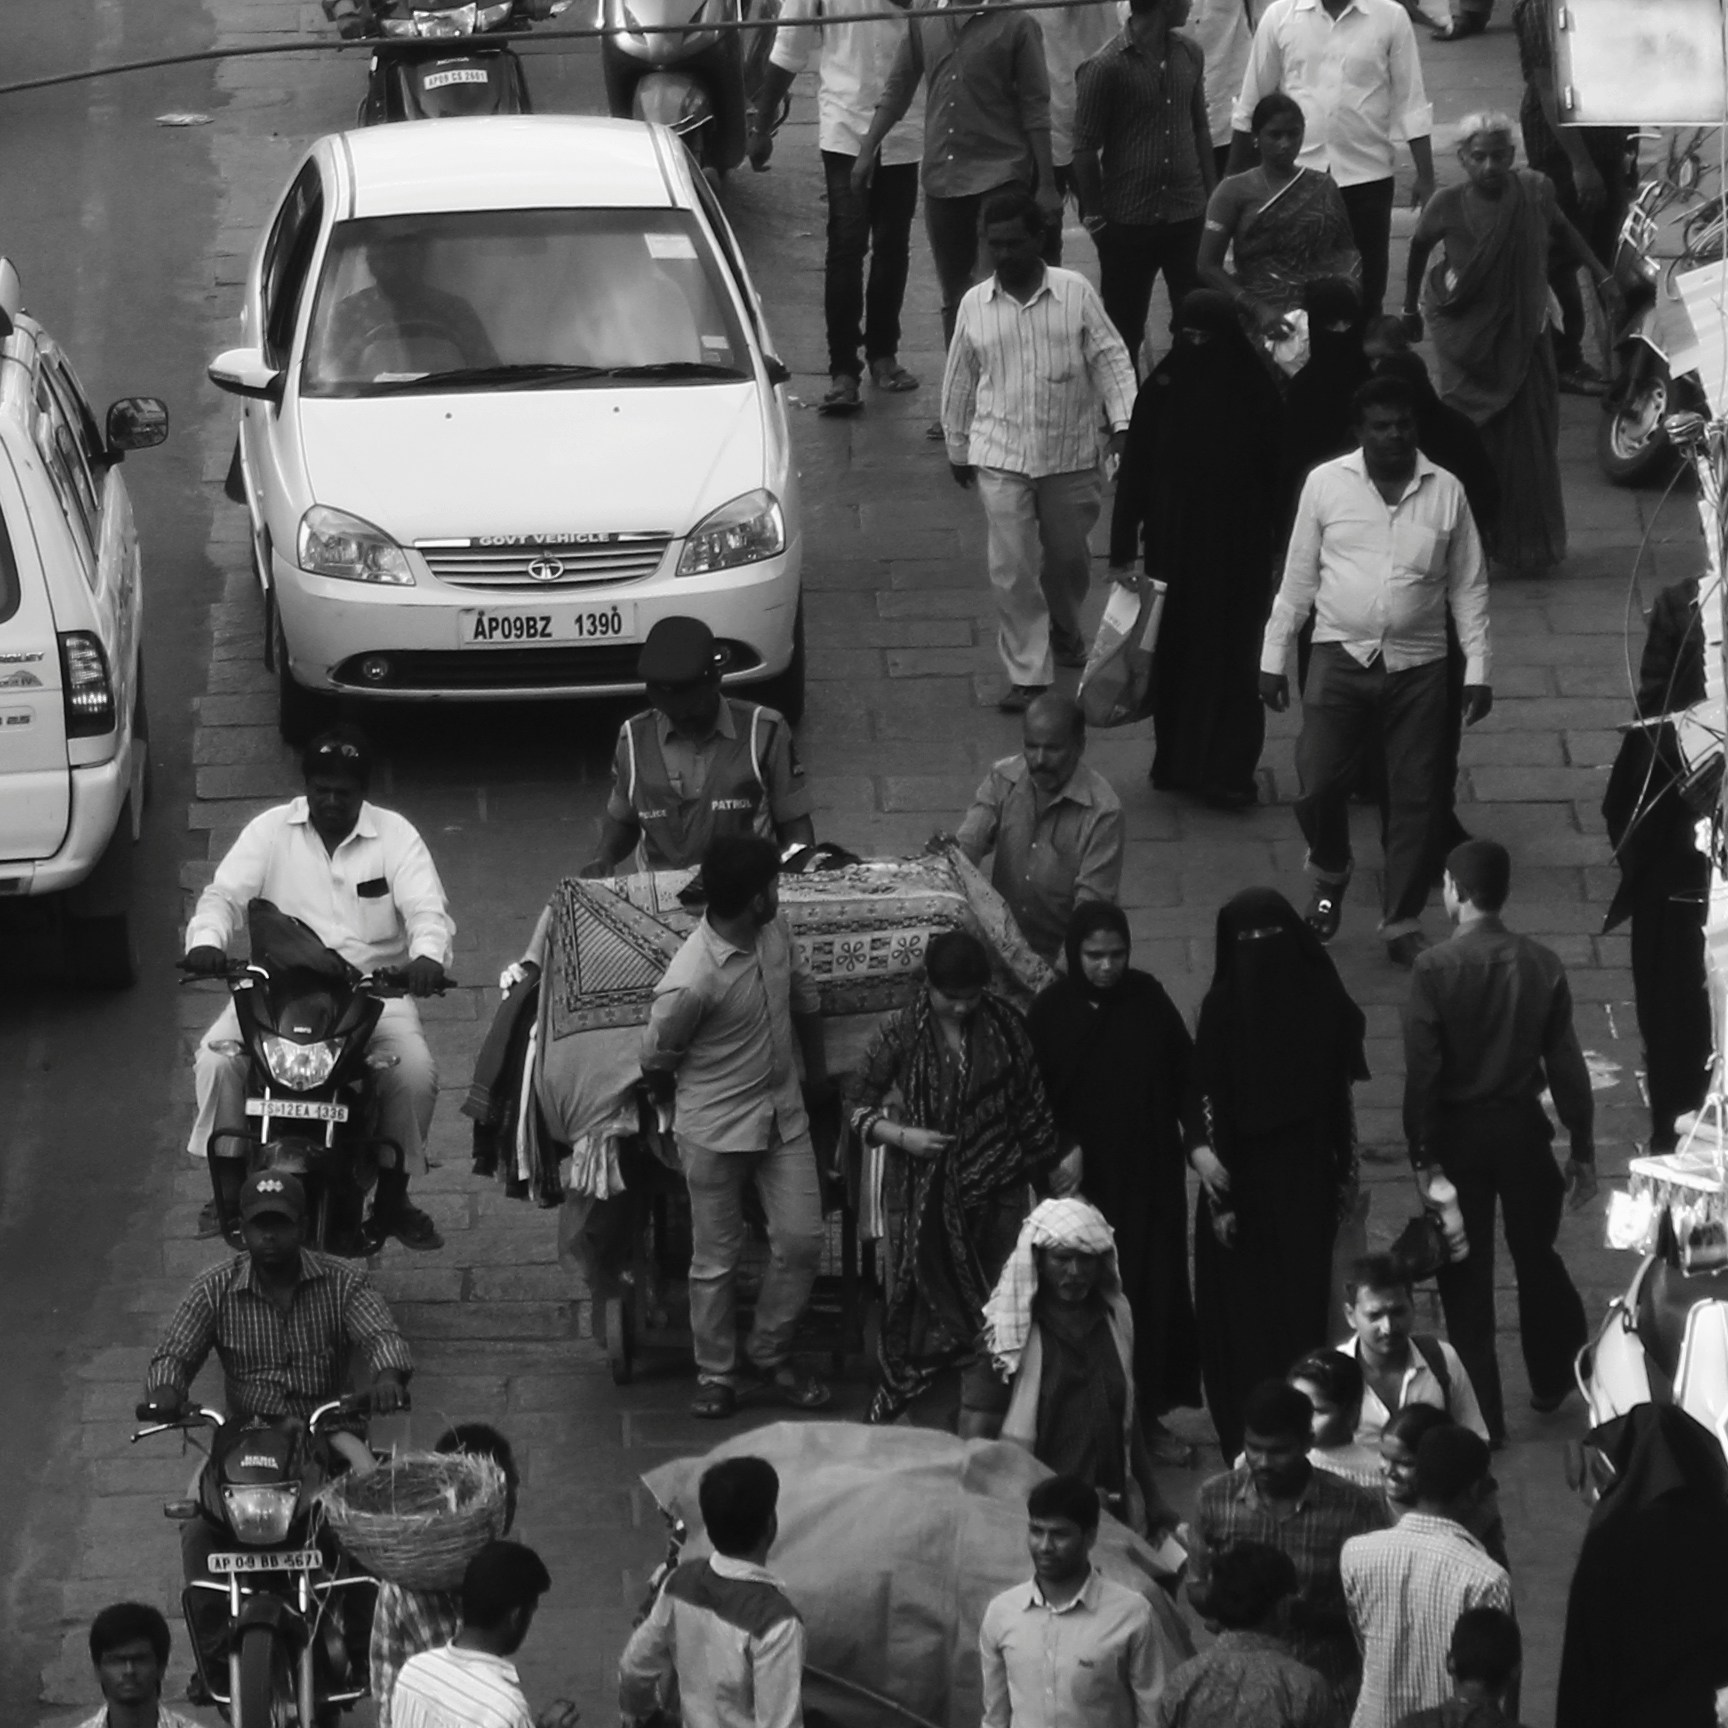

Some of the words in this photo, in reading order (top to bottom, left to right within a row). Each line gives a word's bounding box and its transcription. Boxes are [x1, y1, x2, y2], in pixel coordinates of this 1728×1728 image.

[479, 534, 535, 546] GOVT
[540, 532, 610, 545] VEHICLE
[473, 613, 554, 641] AP09BZ
[574, 610, 623, 639] 1390
[213, 1558, 231, 1571] AP
